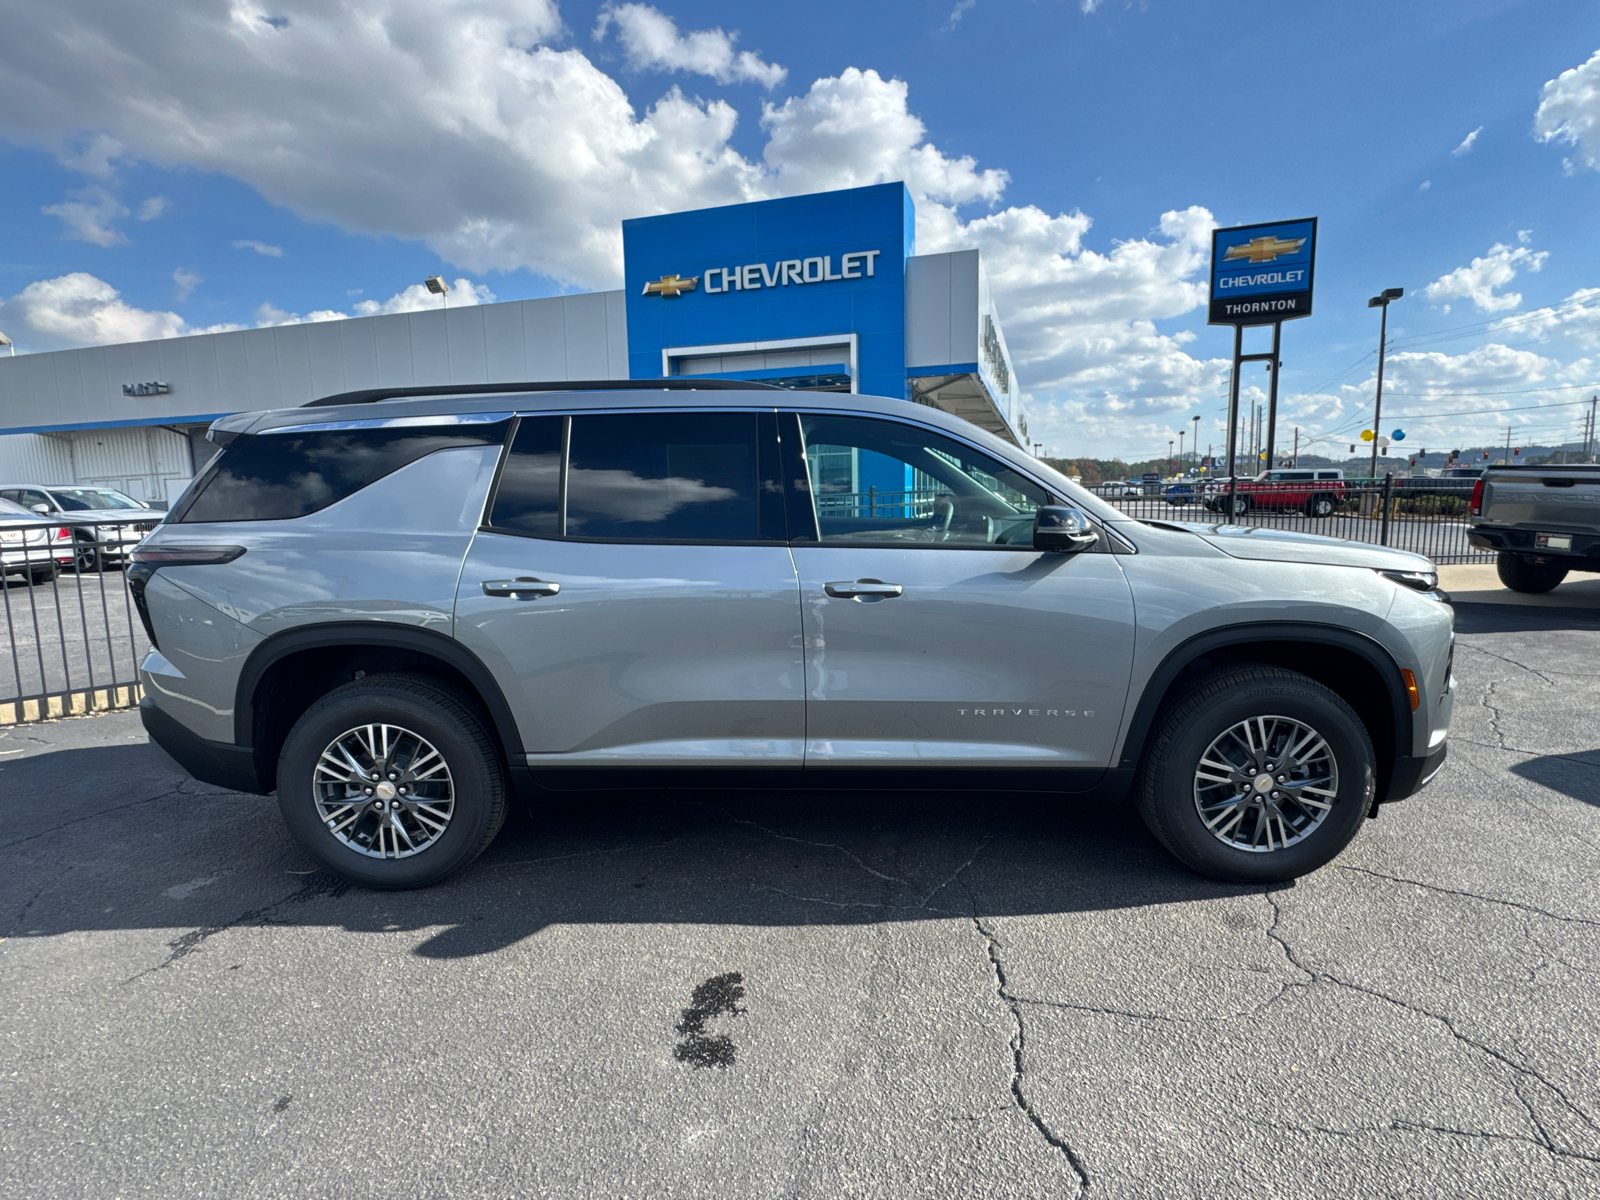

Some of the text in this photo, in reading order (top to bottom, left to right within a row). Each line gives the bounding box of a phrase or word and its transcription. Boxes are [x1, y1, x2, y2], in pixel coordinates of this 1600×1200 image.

[704, 250, 880, 294] CHEVROLET
[1219, 270, 1305, 289] CHEVROLET
[1225, 299, 1297, 315] THORNTON
[122, 381, 163, 397] PARTS
[1243, 687, 1318, 701] BRIDGESTONE
[956, 709, 1096, 718] TRAVERSE
